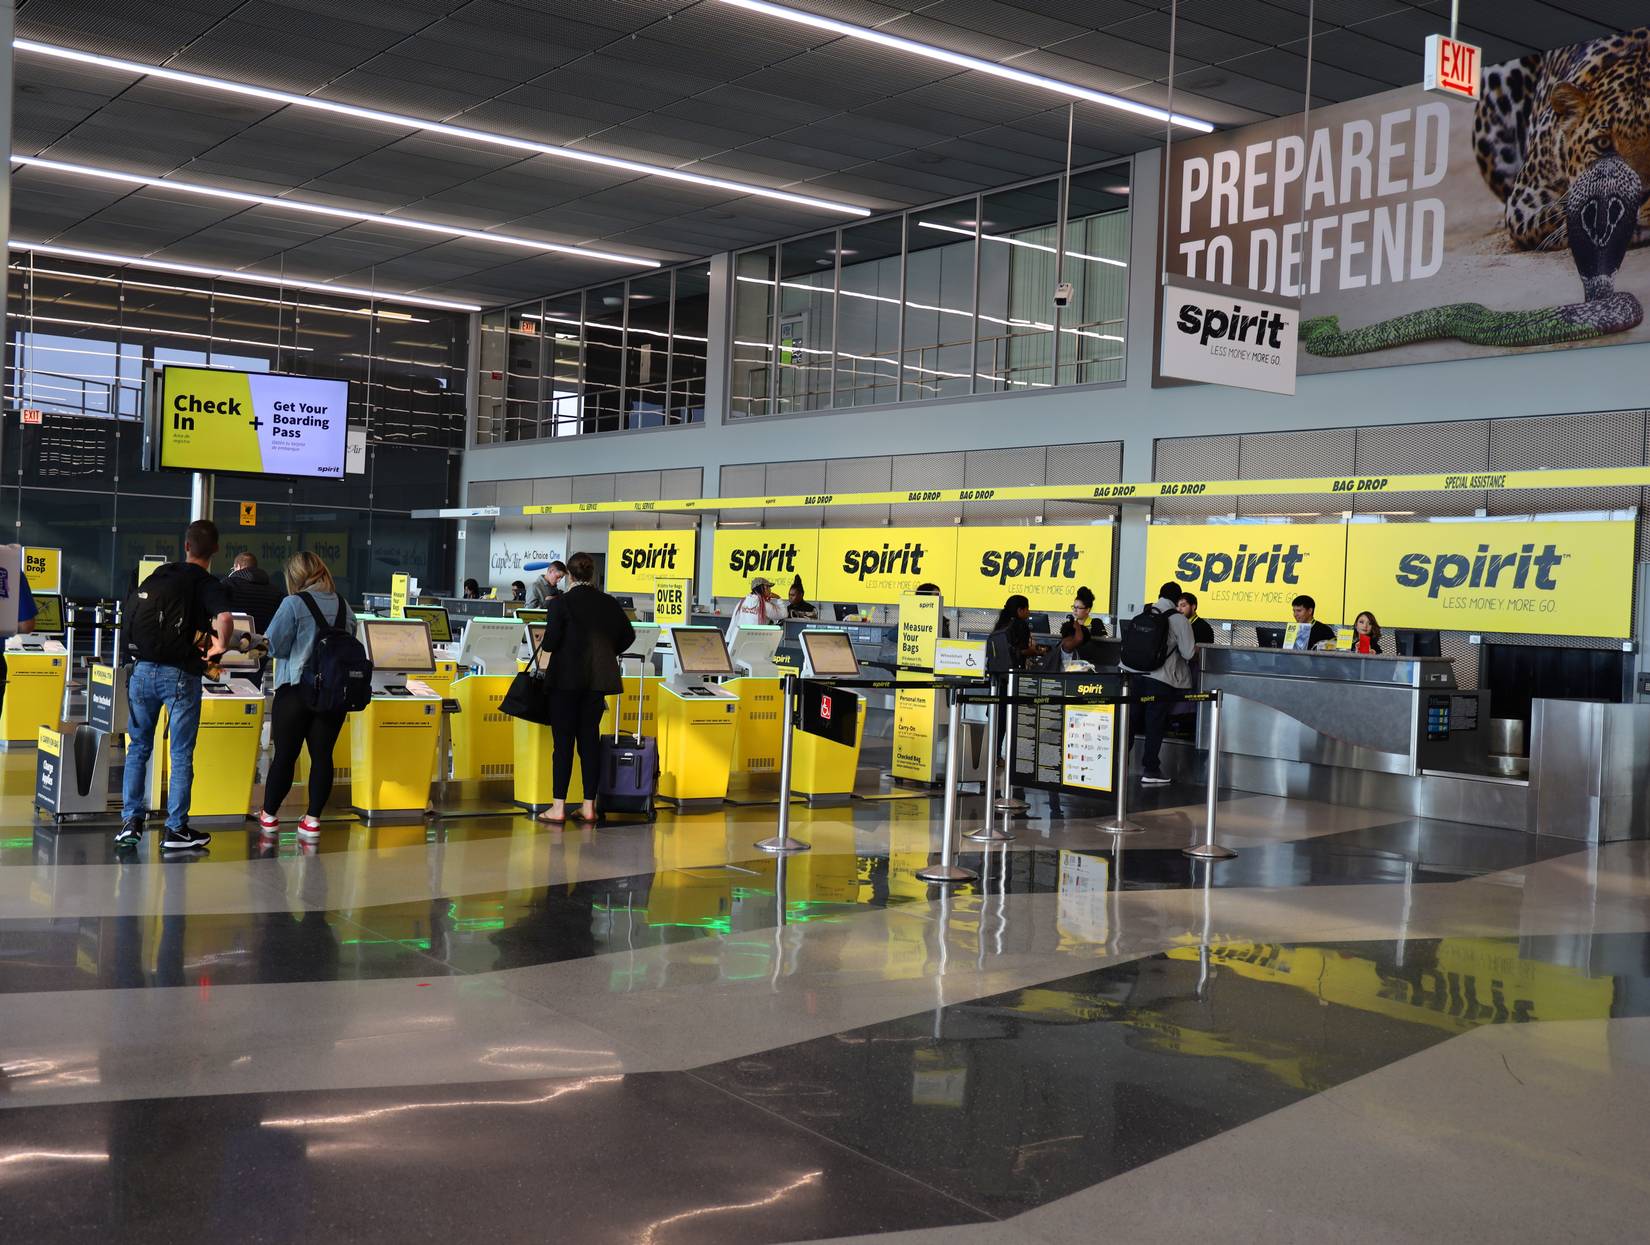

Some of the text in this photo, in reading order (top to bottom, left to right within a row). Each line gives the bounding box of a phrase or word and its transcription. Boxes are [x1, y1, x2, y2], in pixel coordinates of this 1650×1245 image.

[1441, 39, 1475, 84] EXIT
[1180, 102, 1450, 234] PREPARED
[1179, 198, 1446, 297] TO DEFEND
[1177, 304, 1284, 349] spirit
[1210, 345, 1227, 357] LESS
[1251, 352, 1269, 364] MORE
[174, 395, 241, 416] Check
[273, 401, 328, 415] Get Your
[23, 410, 39, 421] EXIT
[173, 413, 195, 431] In
[273, 414, 330, 430] Boarding
[272, 427, 301, 439] Pass
[317, 465, 340, 473] spirit
[1332, 478, 1388, 492] BAG DROP
[1444, 474, 1506, 490] SPECIAL ASSISTANCE
[959, 490, 995, 500] BAG DROP
[1093, 486, 1136, 497] BAG DROP
[1160, 483, 1206, 495] BAG DROP
[804, 495, 833, 505] BAG DROP
[908, 491, 941, 501] BAG DROP
[26, 555, 46, 567] Bag
[524, 550, 561, 560] Air Choice One
[621, 543, 677, 575] spirit
[729, 543, 797, 578] spirit
[26, 564, 46, 573] Drop
[843, 543, 925, 582] spirit
[980, 543, 1079, 586] spirit
[1175, 544, 1304, 592] spirit
[1395, 543, 1563, 599] spirit
[657, 589, 683, 603] OVER
[1008, 584, 1023, 594] LESS
[1047, 586, 1064, 596] MORE
[1211, 590, 1230, 601] LESS
[1260, 592, 1283, 604] MORE
[656, 603, 682, 615] 40 LBS
[1442, 597, 1467, 609] LESS
[1507, 599, 1535, 612] MORE
[903, 622, 933, 633] Measure
[902, 632, 919, 642] Your
[902, 642, 919, 655] Bags
[772, 654, 791, 664] spirit
[1077, 683, 1103, 695] spirit
[899, 695, 916, 703] Personal
[898, 724, 916, 732] Carry-On
[913, 754, 921, 763] Bag
